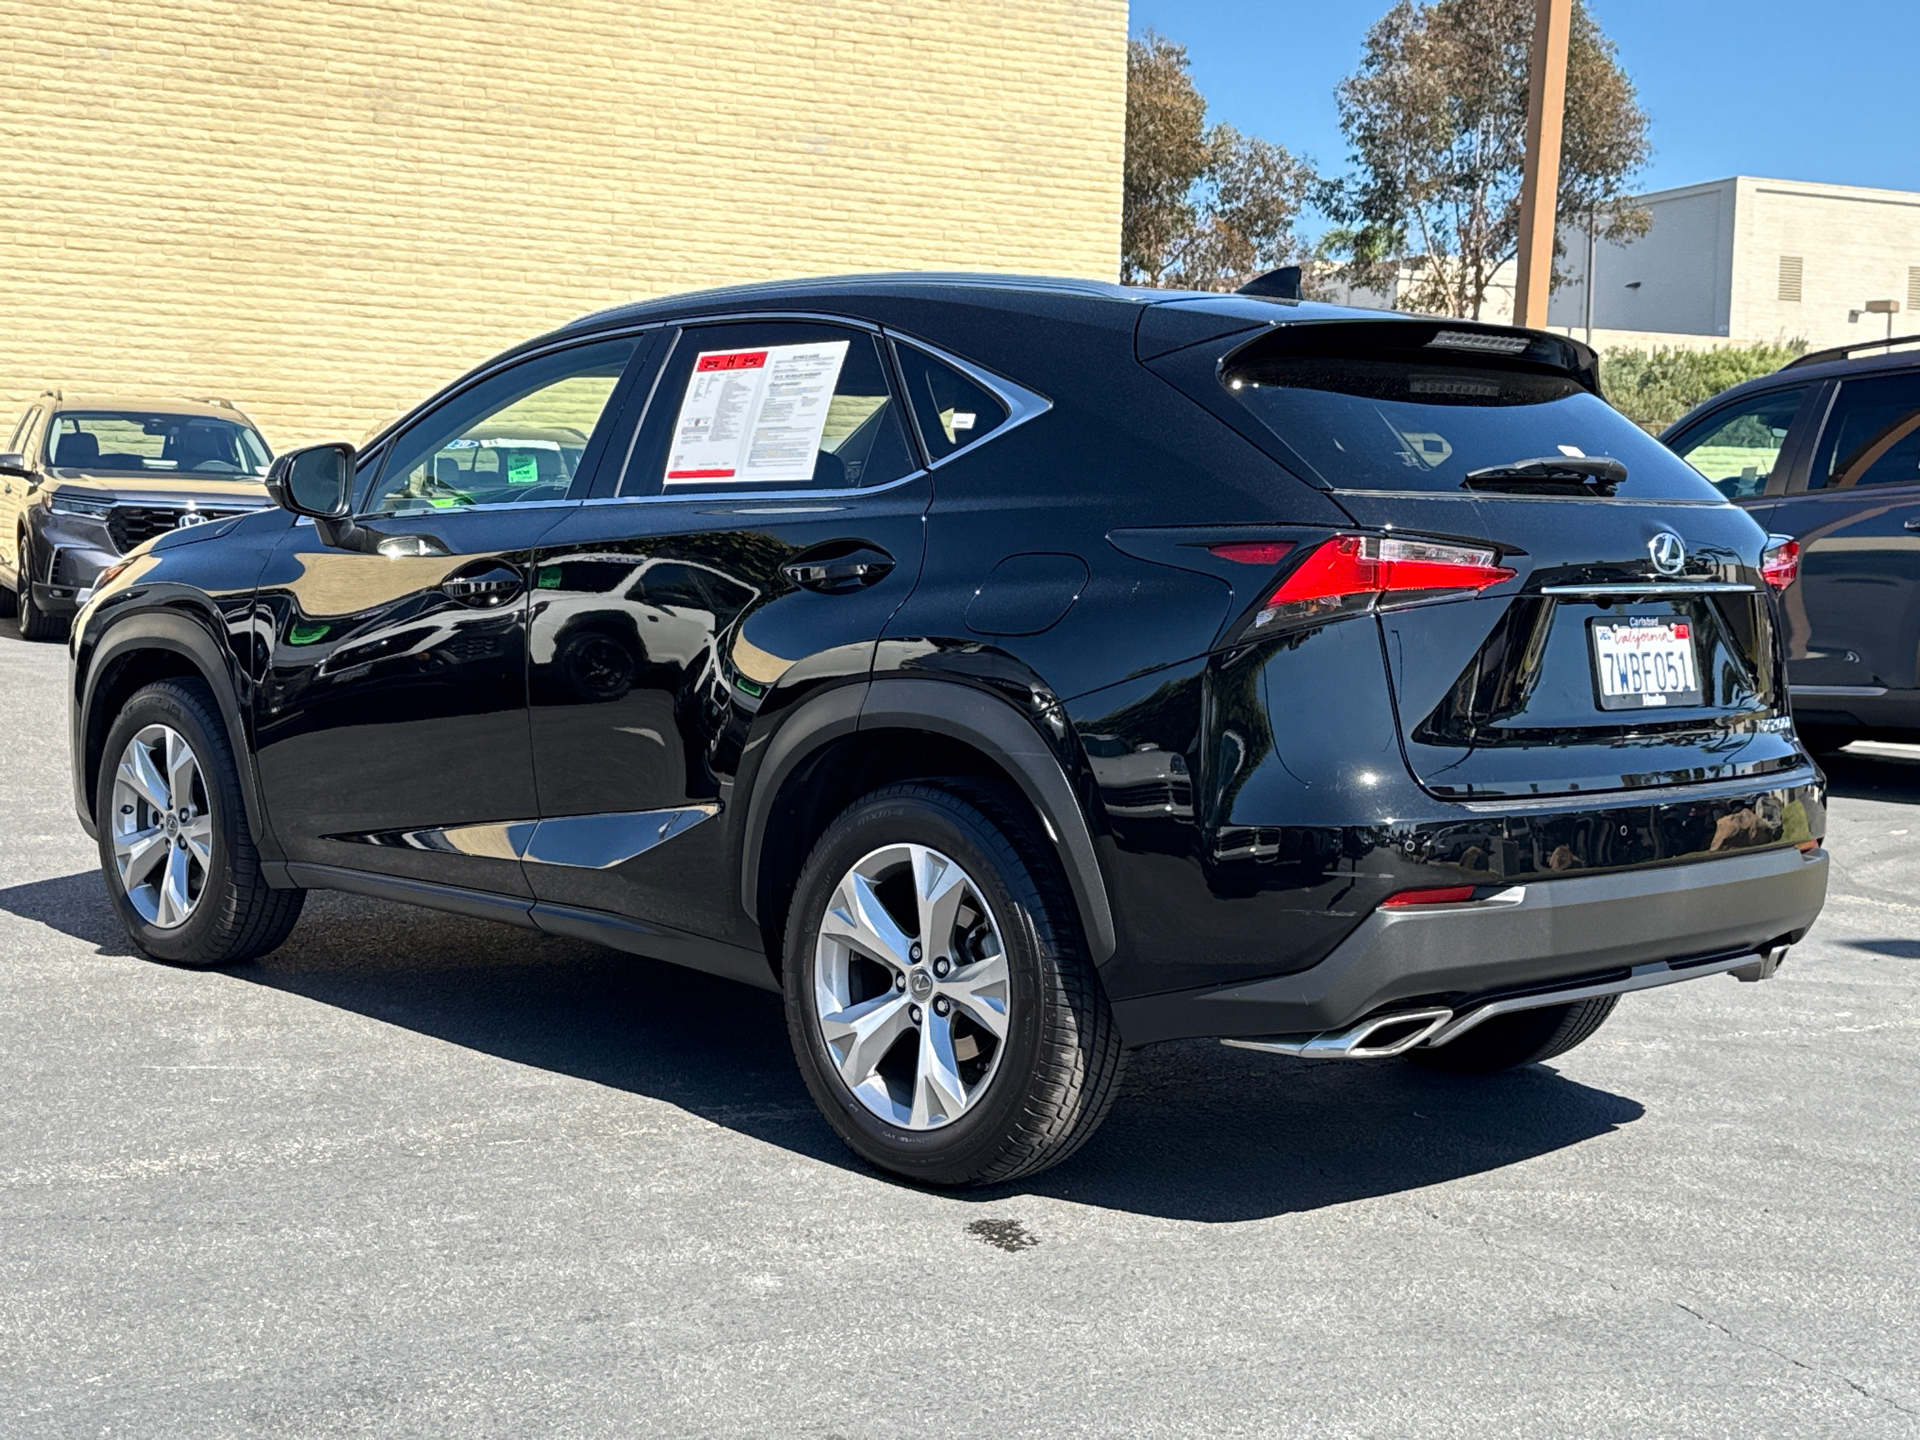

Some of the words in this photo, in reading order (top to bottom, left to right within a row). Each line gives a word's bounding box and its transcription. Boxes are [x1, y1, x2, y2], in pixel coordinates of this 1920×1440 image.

[1629, 617, 1659, 627] Carlsbad
[1614, 628, 1675, 650] California
[1602, 650, 1691, 693] 7WBF051
